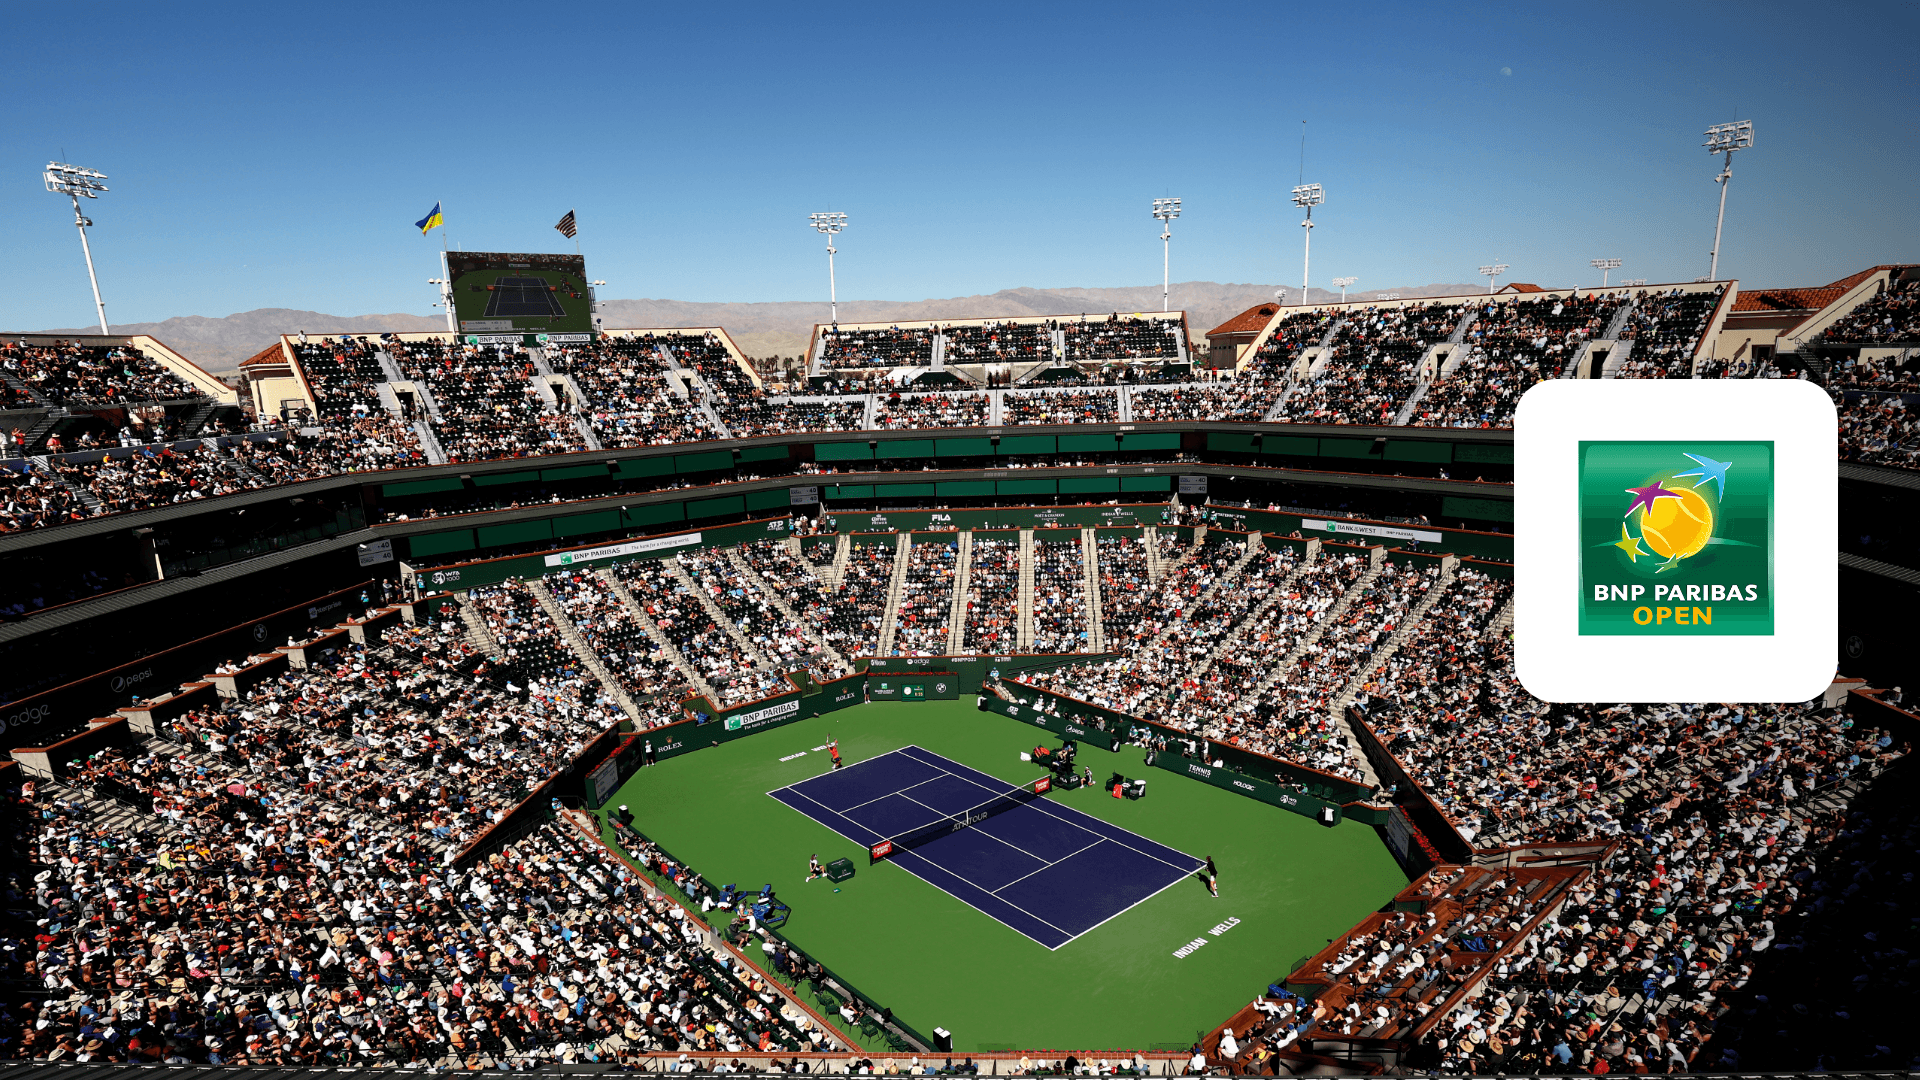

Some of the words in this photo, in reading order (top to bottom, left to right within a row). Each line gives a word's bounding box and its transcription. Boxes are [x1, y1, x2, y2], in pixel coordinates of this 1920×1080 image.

[574, 551, 589, 560] BNP
[591, 547, 621, 557] PARIBAS
[126, 668, 153, 686] pepsi
[835, 692, 855, 702] ROLEX
[9, 704, 51, 727] edge
[743, 712, 760, 723] BNP
[763, 701, 796, 718] PARIBAS
[657, 741, 683, 753] ROLEX
[1189, 763, 1212, 776] TENNIS
[1233, 780, 1256, 792] HOLOGIC
[968, 811, 988, 825] TOUR
[1208, 916, 1241, 936] WELLS
[1172, 936, 1208, 959] INDIAN
